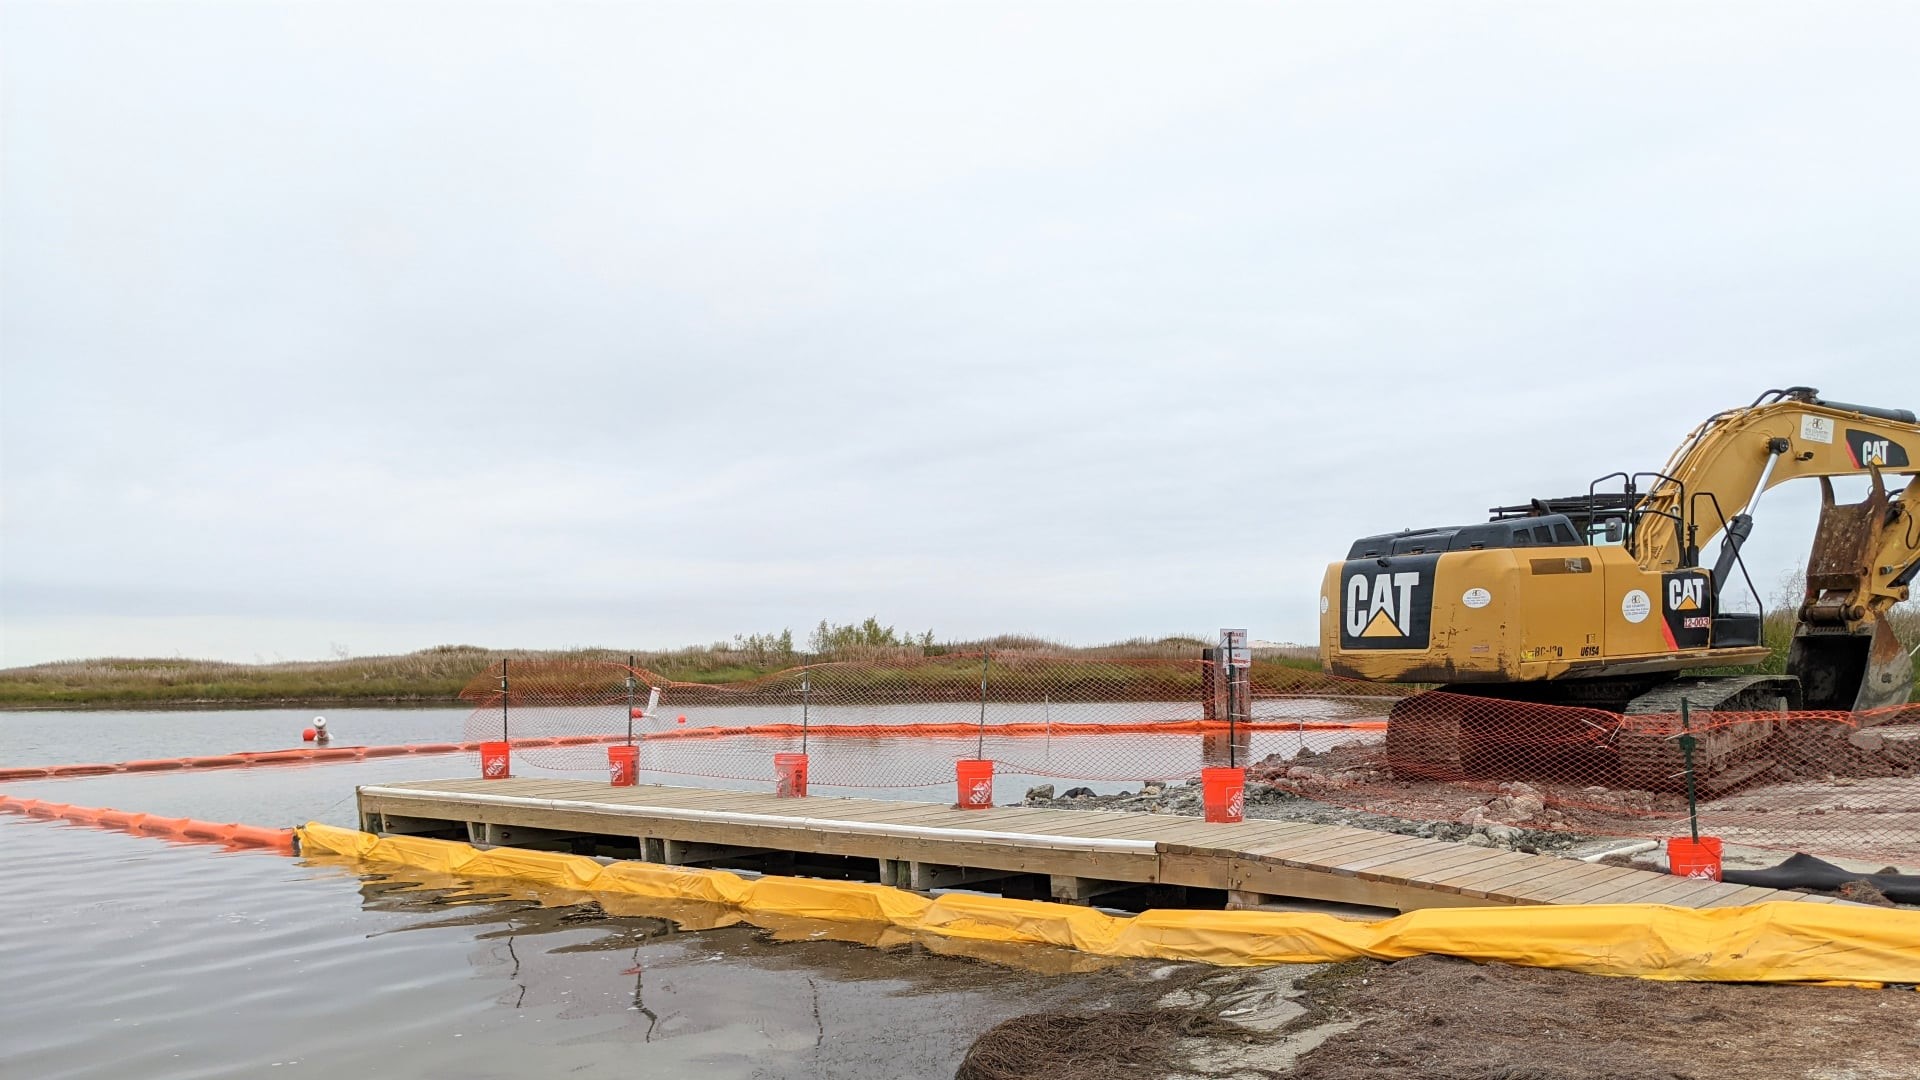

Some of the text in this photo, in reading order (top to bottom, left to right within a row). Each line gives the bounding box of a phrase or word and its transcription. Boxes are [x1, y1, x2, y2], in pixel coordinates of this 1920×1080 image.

[1862, 440, 1889, 466] CAT
[1346, 571, 1420, 638] CAT
[1668, 578, 1704, 610] CAT
